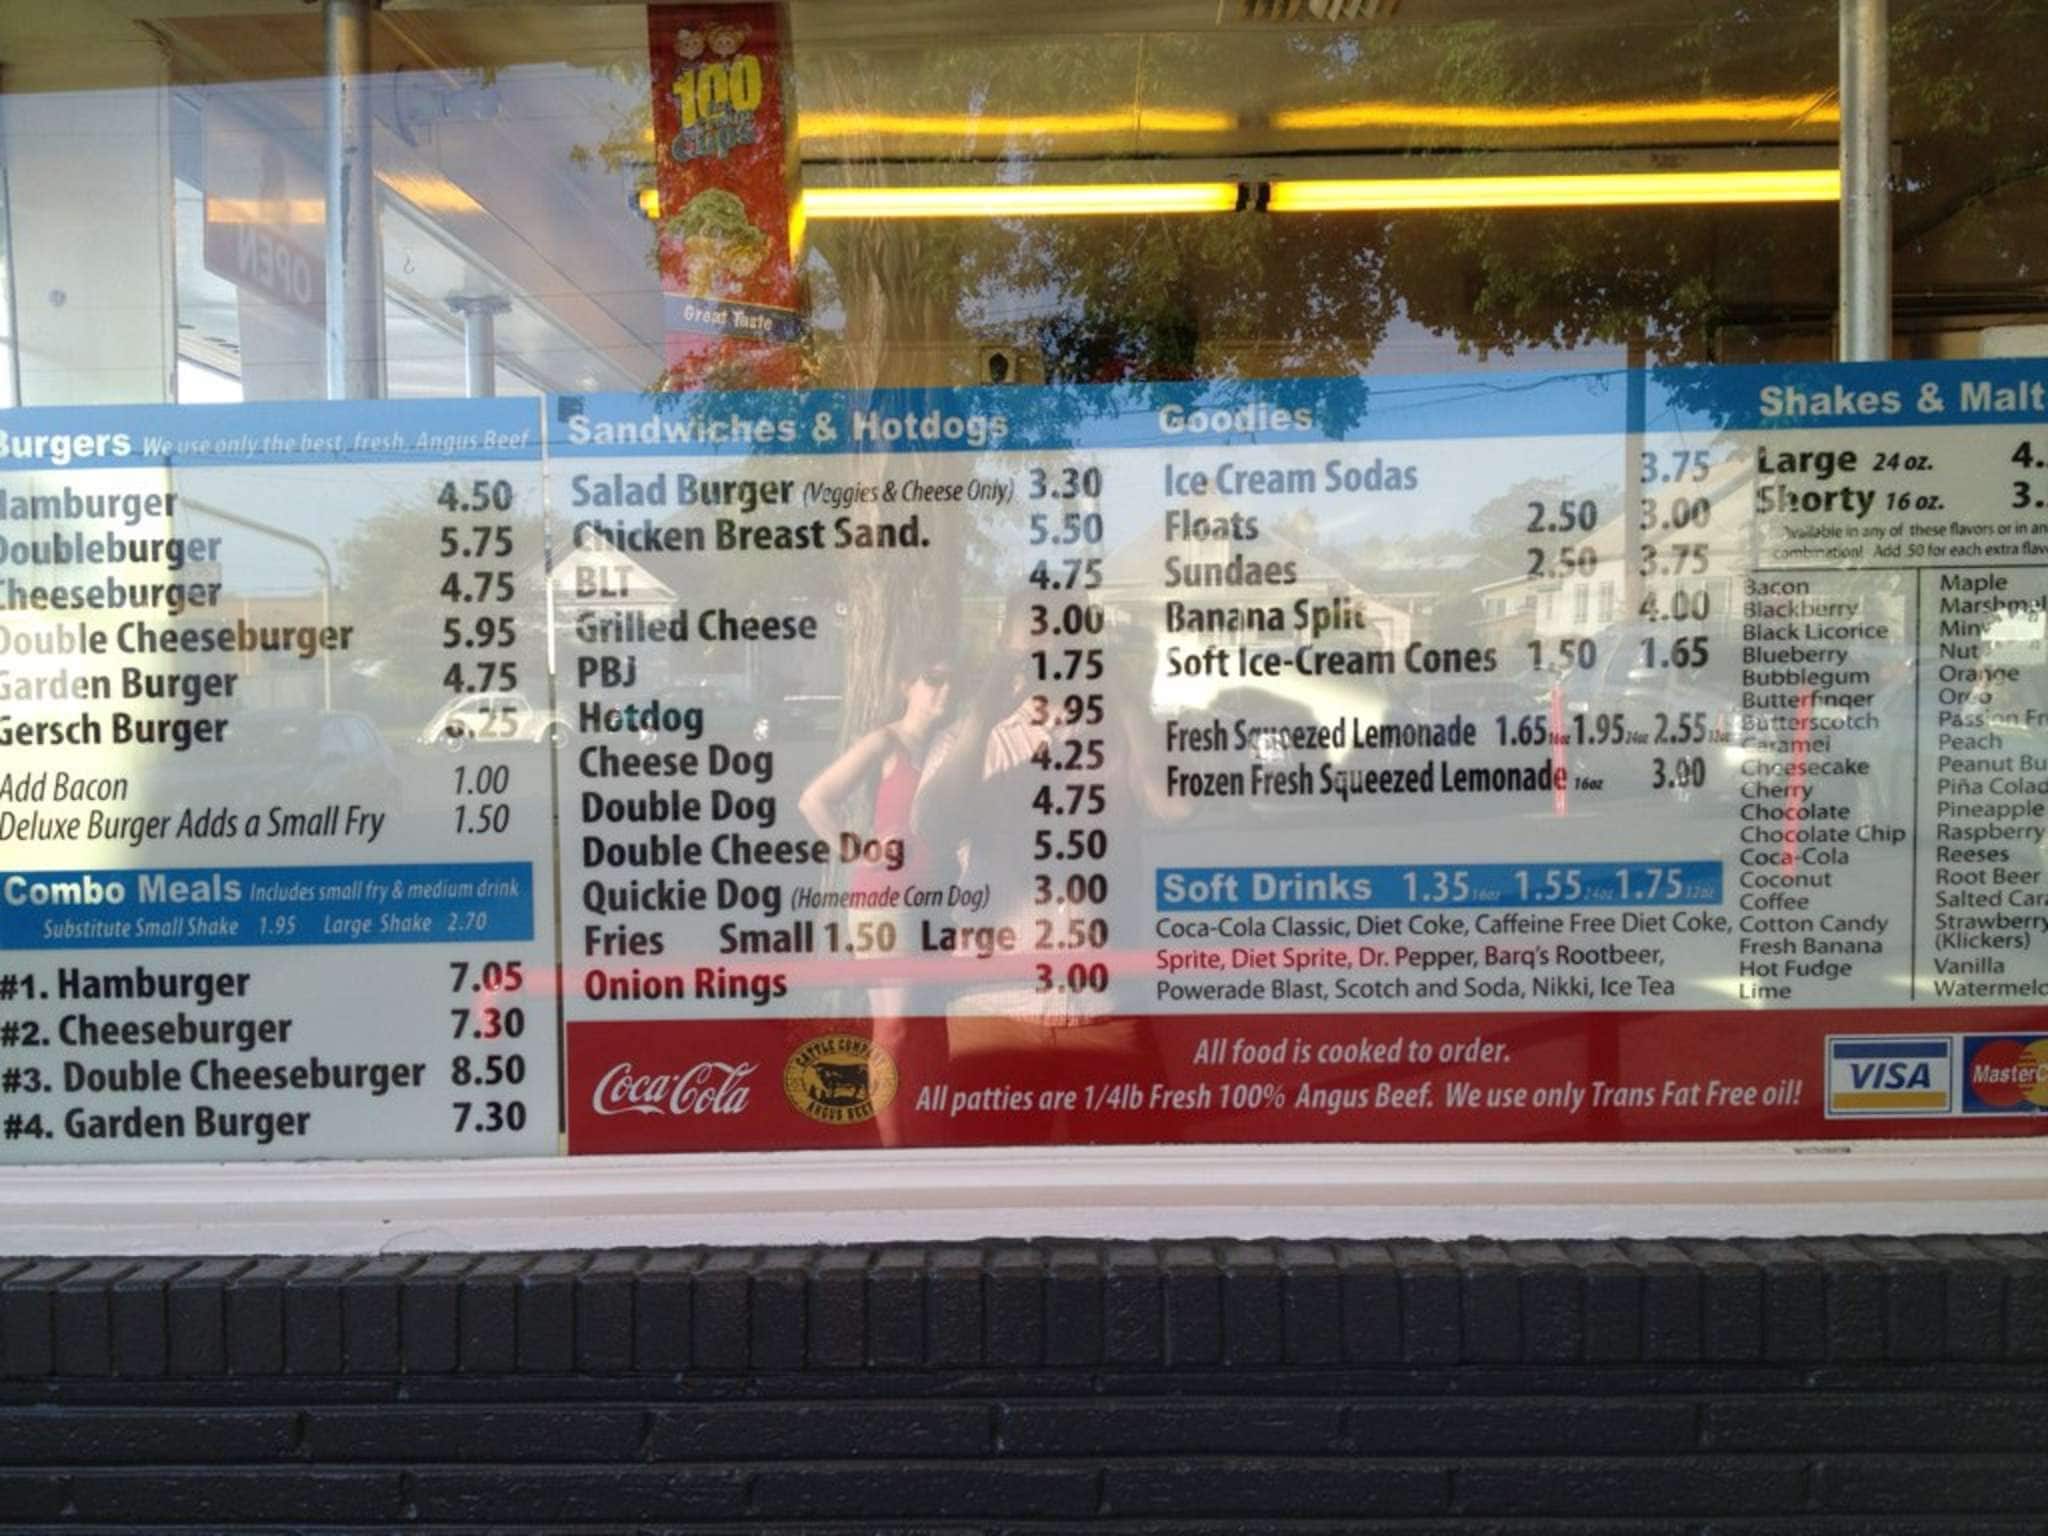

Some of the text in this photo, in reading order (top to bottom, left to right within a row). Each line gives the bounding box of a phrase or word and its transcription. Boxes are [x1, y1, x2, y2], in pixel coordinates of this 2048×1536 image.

[683, 305, 772, 331] Great Taste
[1759, 385, 1903, 417] Shakes
[1918, 382, 1944, 412] &
[567, 412, 1009, 448] Sandwiches & Hotdogs
[1158, 403, 1313, 434] Goodies
[143, 436, 170, 456] We
[174, 439, 205, 454] use
[205, 436, 257, 459] only
[257, 435, 294, 453] the
[415, 431, 478, 454] Angus
[483, 430, 530, 449] Beef
[1164, 450, 1710, 496] Ice Cream Sodas 3.75
[572, 467, 1101, 513] Salad Burger (Veggies & Cheese Only) 3.30
[1940, 574, 2007, 594] Maple
[1743, 623, 1888, 642] Black Licorice
[1742, 669, 1870, 688] Bubblegum
[0, 766, 509, 803] Add Bacon 1.00
[0, 804, 509, 846] Deluxe Burger Adds a Small Fry 1.50
[1740, 826, 1905, 845] Chocolate Chip
[1937, 823, 2045, 844] Raspberry
[1740, 849, 1849, 866] Coca-Cola
[1937, 846, 2009, 862] Reeses
[4, 874, 520, 906] Combo Meals Includes small fry & medium drink
[584, 874, 1106, 916] Quickie Dog (Homemade Corn Dog) 3.00
[1163, 874, 1238, 902] Soft
[1253, 873, 1372, 900] Drinks
[1403, 871, 1469, 901] 1.35
[1515, 870, 1582, 900] 1.55
[1615, 869, 1682, 899] 1.75
[44, 913, 487, 939] Substitute Small Shake 1.95 Large Shake 2.70
[1156, 911, 1732, 939] Coca-Cola Classic, Diet Coke, Caffeine Free Diet Coke,
[1740, 914, 1887, 934] Cotton Candy
[1156, 944, 1664, 974] Sprite, Diet Sprite, Dr. Pepper, Barq's Rootbeer,
[1740, 938, 1883, 955] Fresh Banana
[1740, 960, 1852, 981] Hot Fudge
[1934, 958, 2004, 975] Vanilla
[0, 961, 522, 1005] #1. Hamburger 7.05
[584, 963, 1108, 1005] Onion Rings 3.00
[1157, 976, 1675, 1002] Powerade Blast, Scotch and Soda, Nikki, Ice Tea
[1740, 983, 1791, 999] Lime
[1, 1008, 524, 1051] #2. Cheeseburger 7.30
[1194, 1036, 1510, 1064] All food is cooked to order.
[3, 1055, 526, 1095] #3. Double Cheeseburger 8.50
[1851, 1063, 1931, 1089] VISA
[915, 1079, 1802, 1117] All patties are 1/4lb Fresh 100% Angus Beef. We use only Trans Fat Free oil!
[4, 1102, 526, 1142] #4. Garden Burger 7.30
